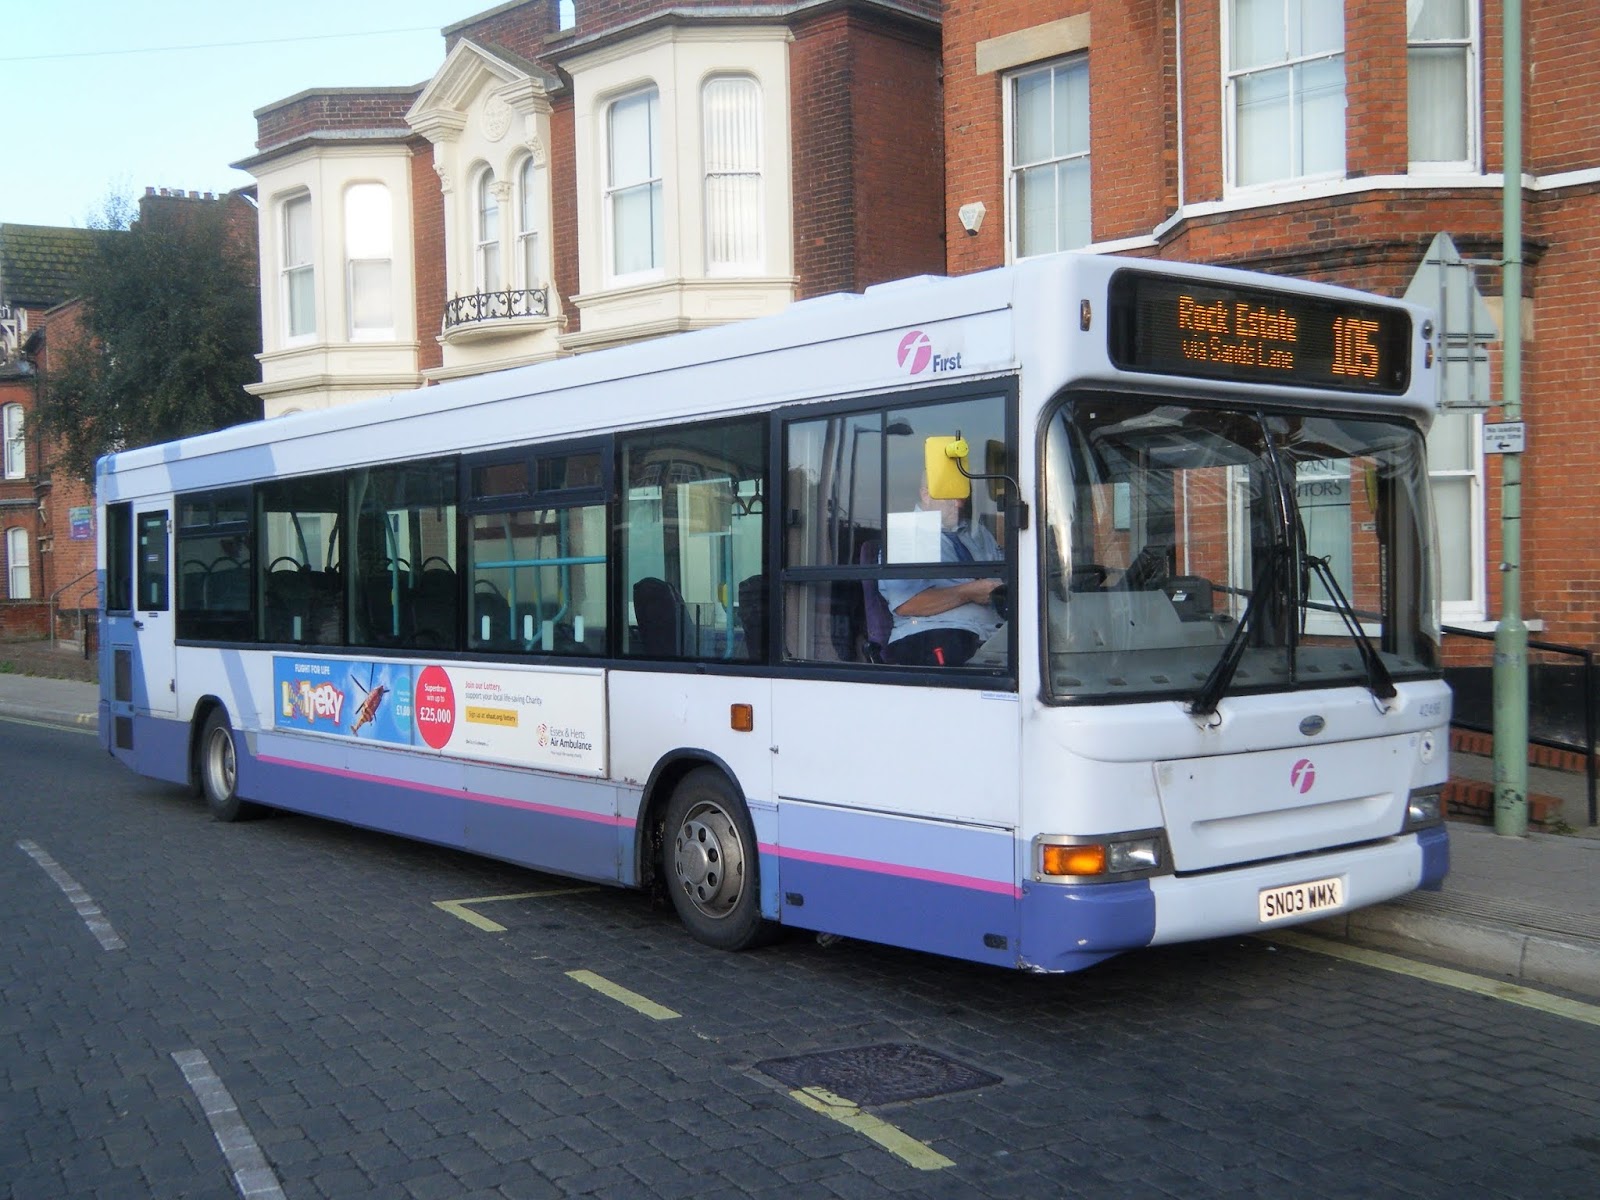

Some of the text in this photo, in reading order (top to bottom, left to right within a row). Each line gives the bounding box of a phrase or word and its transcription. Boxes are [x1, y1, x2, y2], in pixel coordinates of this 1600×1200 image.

[1180, 296, 1297, 341] Rock Estate
[1182, 335, 1294, 369] via Sands Lane
[933, 352, 962, 372] First
[311, 664, 321, 674] FOR
[321, 665, 330, 675] LIFE
[420, 706, 451, 724] £25,000
[550, 726, 564, 737] Essex
[570, 728, 586, 740] Herts
[550, 737, 592, 751] Air Ambulance
[1265, 882, 1337, 917] SN03 WMX
